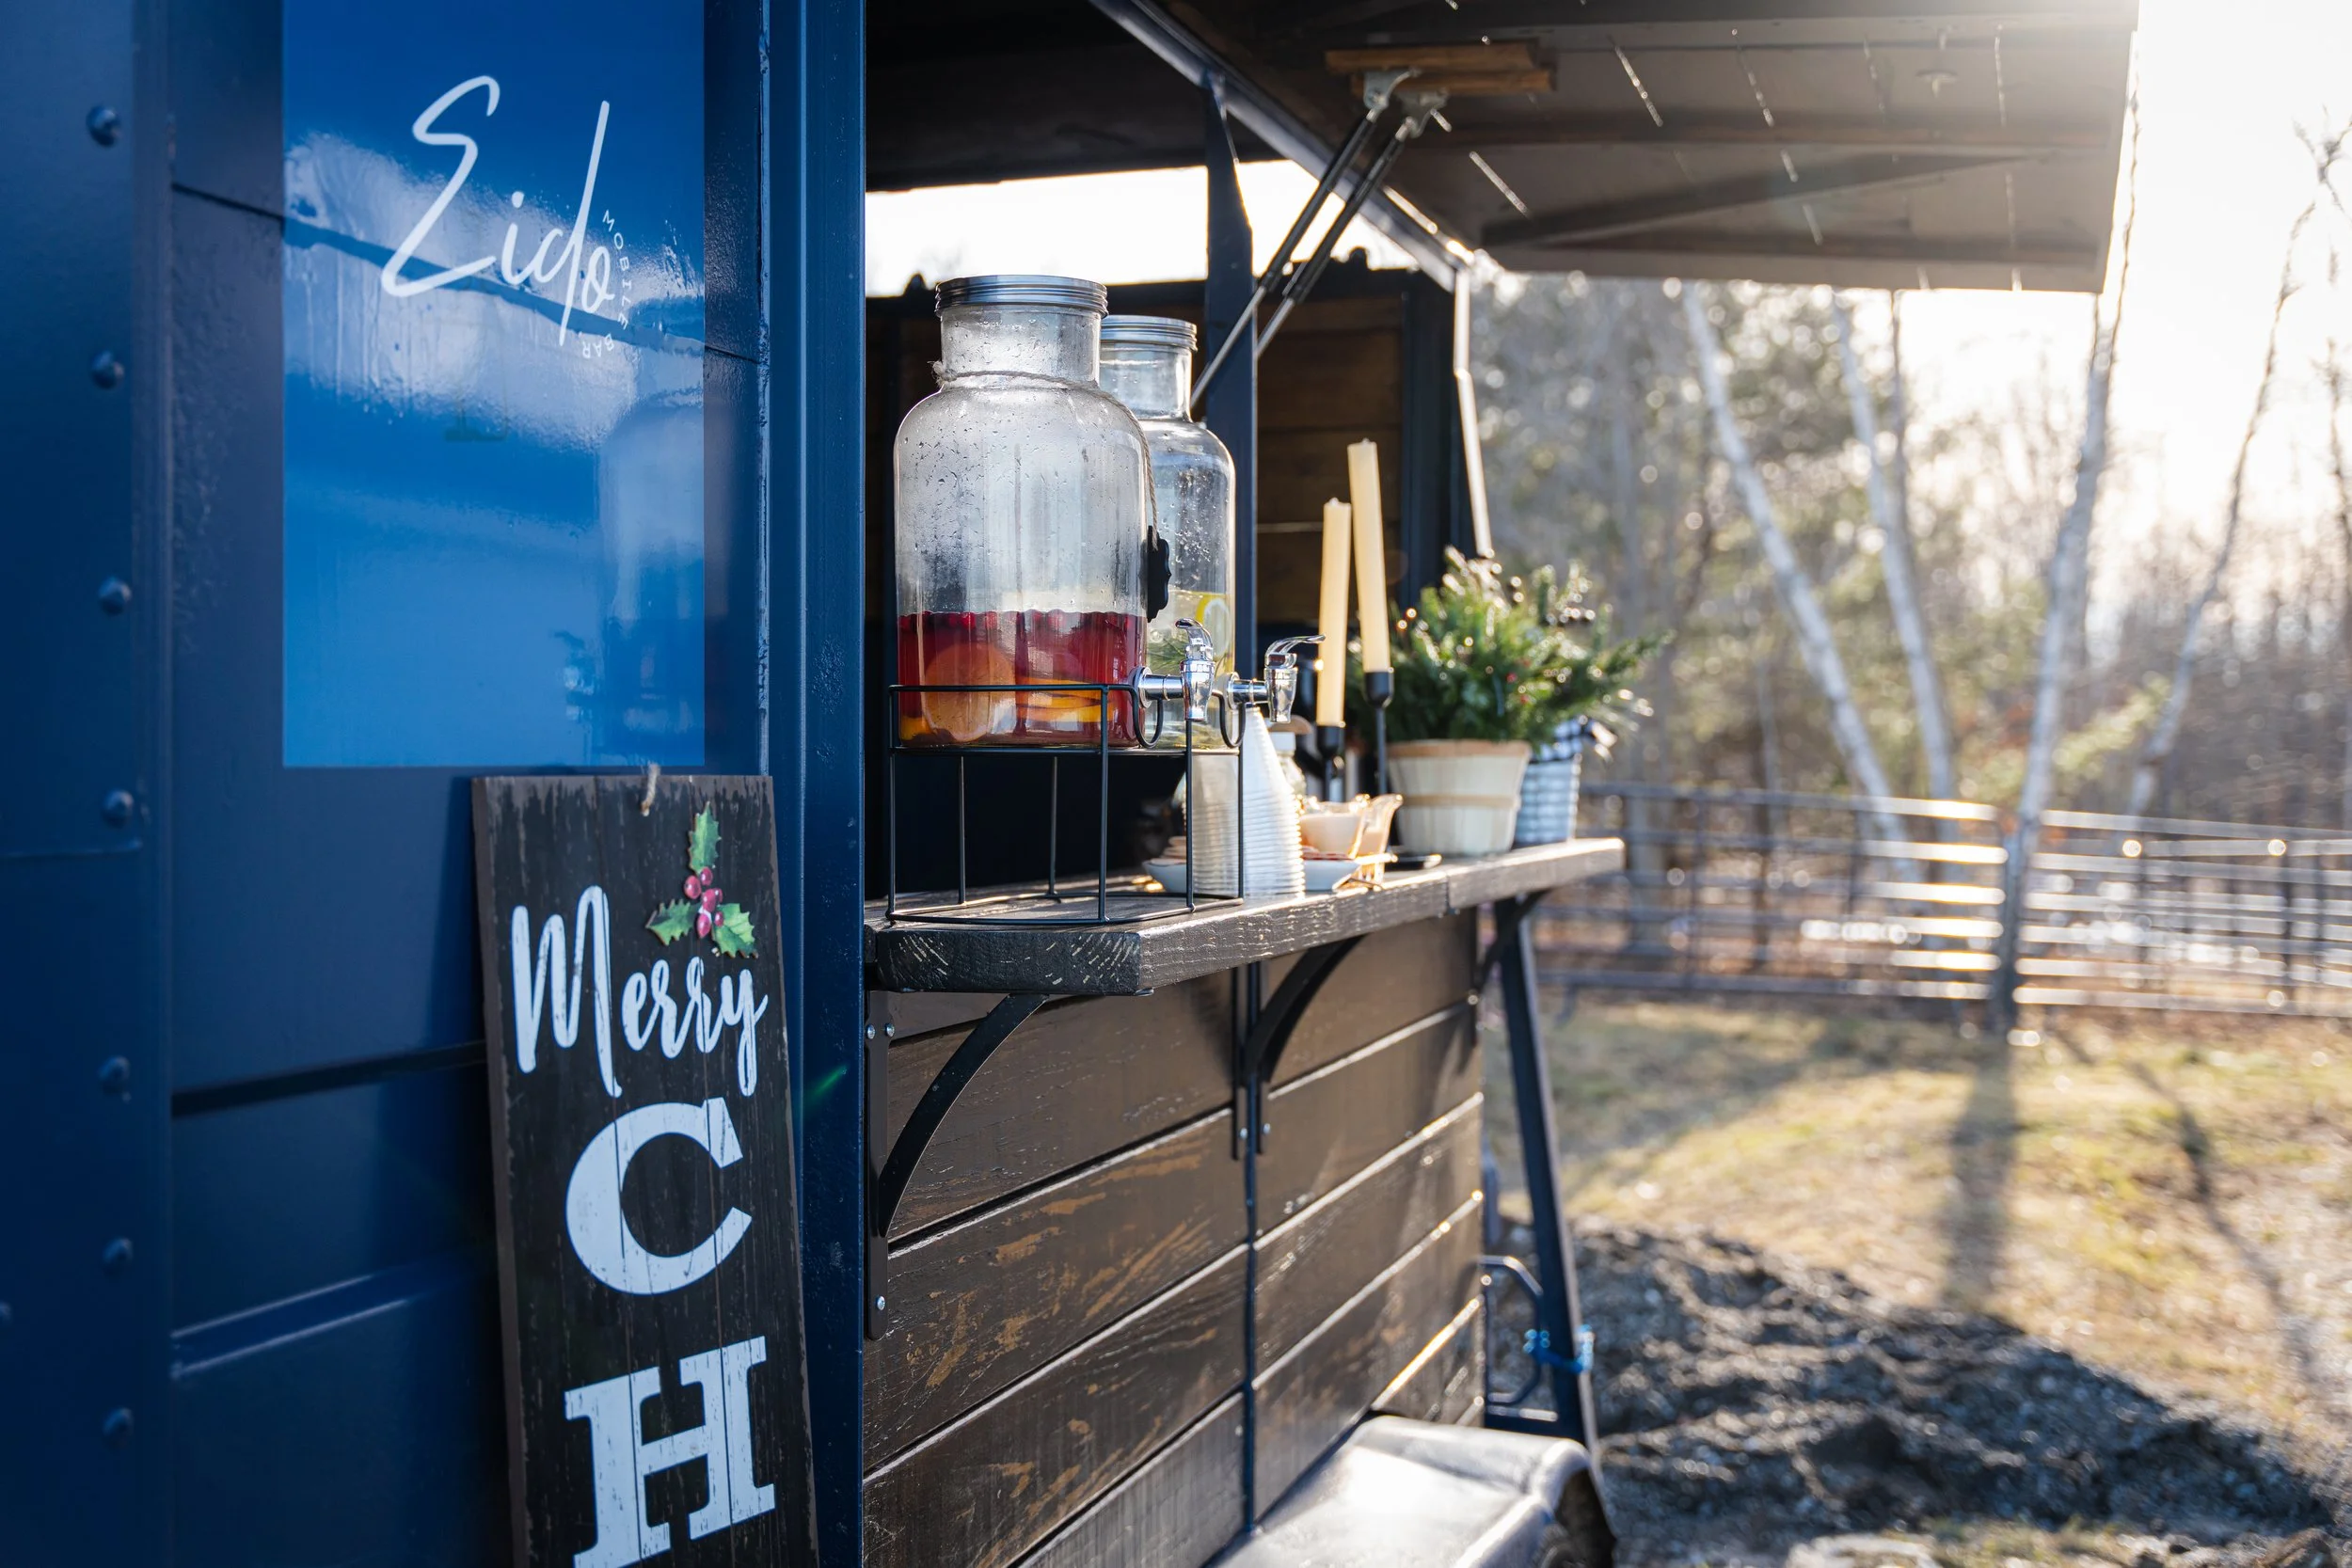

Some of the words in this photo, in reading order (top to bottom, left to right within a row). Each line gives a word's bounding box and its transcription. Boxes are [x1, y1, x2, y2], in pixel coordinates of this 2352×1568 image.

[381, 75, 615, 346] Eido
[602, 210, 631, 330] MOBILE
[581, 333, 614, 359] BAR
[511, 885, 769, 1098] Merry
